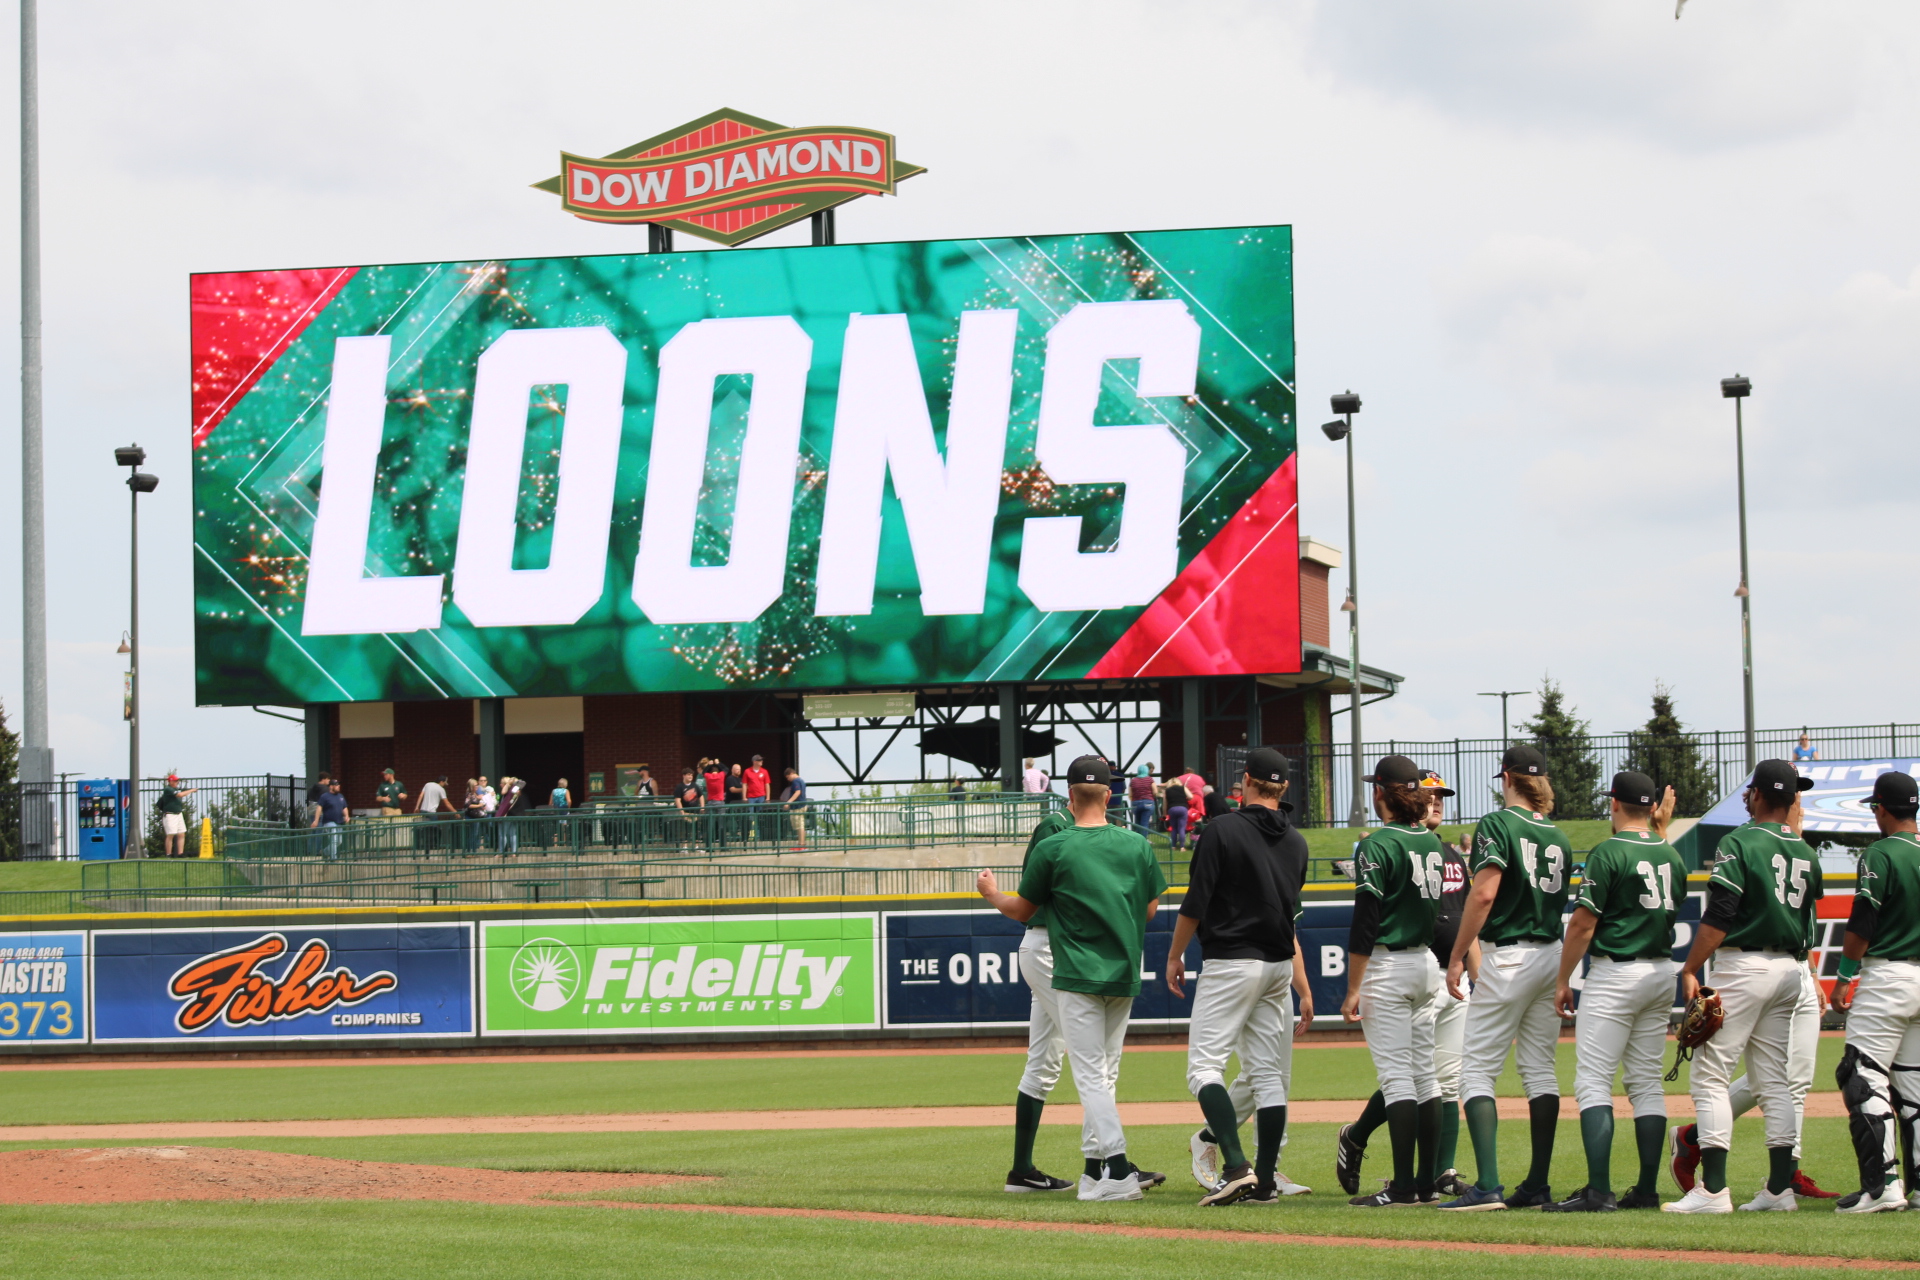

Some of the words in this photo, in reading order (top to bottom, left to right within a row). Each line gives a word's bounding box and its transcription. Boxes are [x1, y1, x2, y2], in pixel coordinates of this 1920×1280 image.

[572, 168, 673, 206] DOW
[684, 139, 881, 198] DIAMOND
[301, 299, 1201, 636] LOONS
[1408, 850, 1442, 899] 46
[1444, 862, 1462, 879] ns
[1520, 837, 1564, 893] 43
[1636, 860, 1674, 910] 31
[1772, 853, 1811, 909] 35
[0, 961, 67, 993] ASTER
[169, 934, 396, 1032] Fisher
[584, 944, 852, 1010] Fidelity
[901, 958, 939, 975] THE
[949, 952, 1019, 984] ORI
[0, 1000, 73, 1035] 373
[331, 1012, 422, 1026] COMPANIES
[582, 999, 792, 1014] INVESTMENTS
